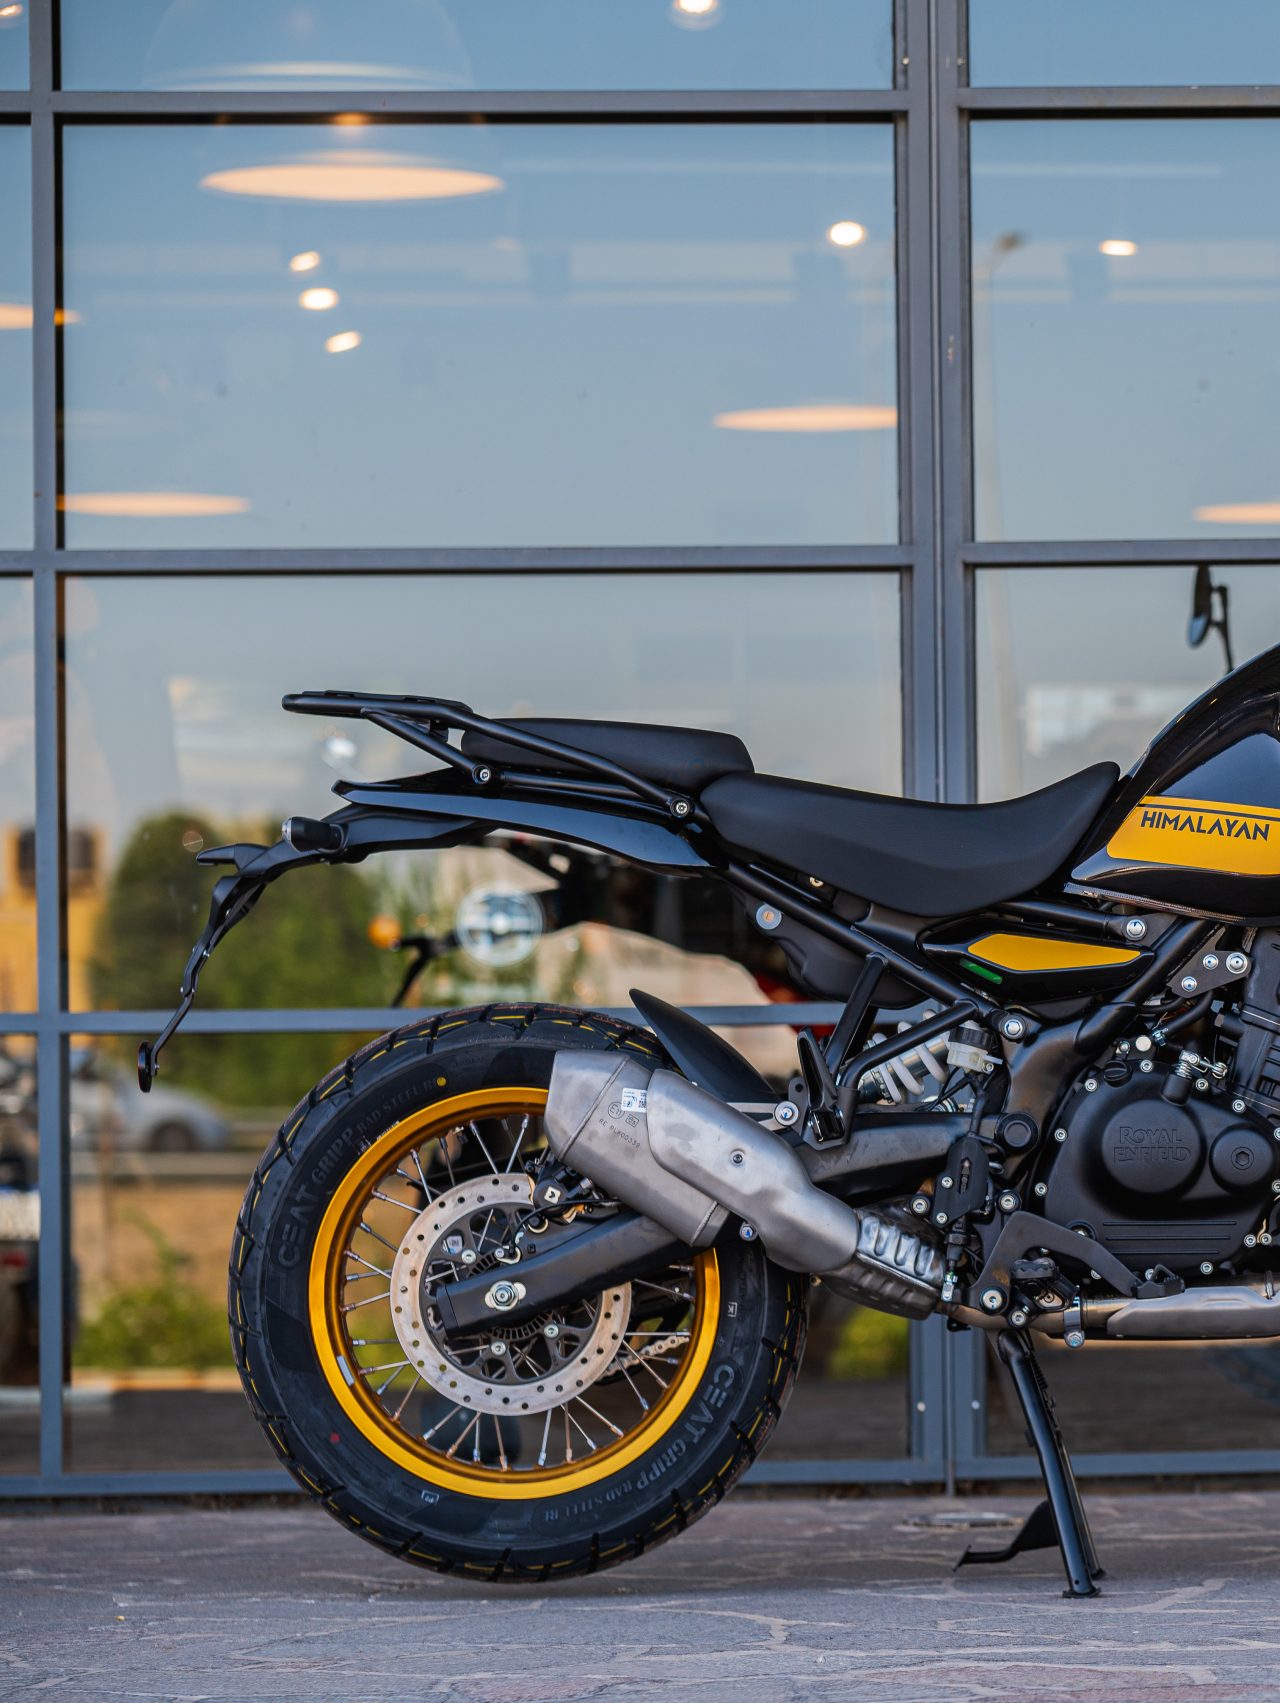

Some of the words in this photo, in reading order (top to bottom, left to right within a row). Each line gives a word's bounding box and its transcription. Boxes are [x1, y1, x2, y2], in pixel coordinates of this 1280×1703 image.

[1140, 810, 1271, 842] HIMALAYAN
[1119, 1126, 1182, 1145] ROYAL
[1113, 1146, 1192, 1164] ENFIELD
[279, 1184, 318, 1267] CEAT
[310, 1128, 357, 1185] GRIPP
[683, 1364, 735, 1443] CEAT
[636, 1441, 687, 1490] GRIPP
[605, 1481, 634, 1502] RAD
